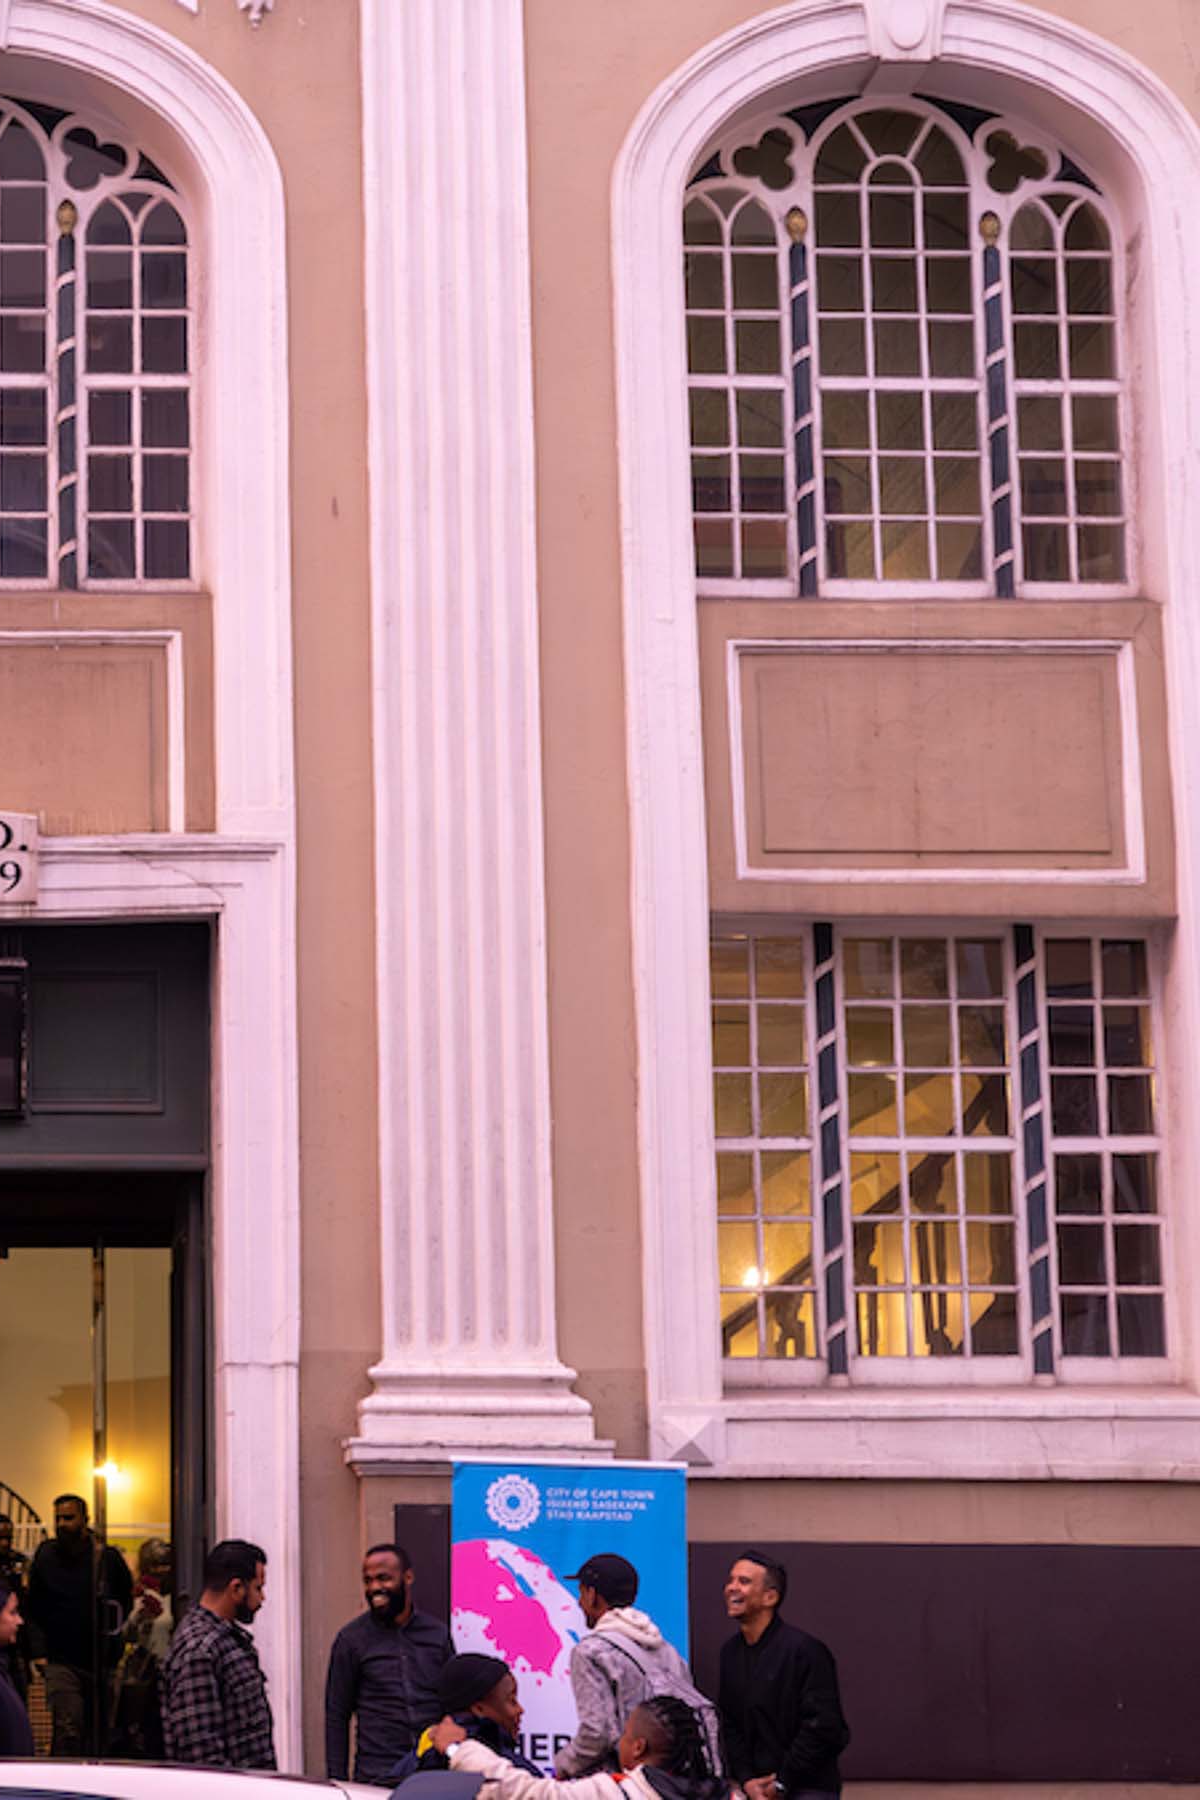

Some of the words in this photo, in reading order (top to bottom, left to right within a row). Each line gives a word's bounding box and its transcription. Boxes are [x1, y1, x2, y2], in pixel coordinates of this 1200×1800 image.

[545, 1487, 571, 1498] CITY
[573, 1488, 588, 1499] OF
[591, 1488, 619, 1499] CAPE
[621, 1489, 655, 1500] TOWN
